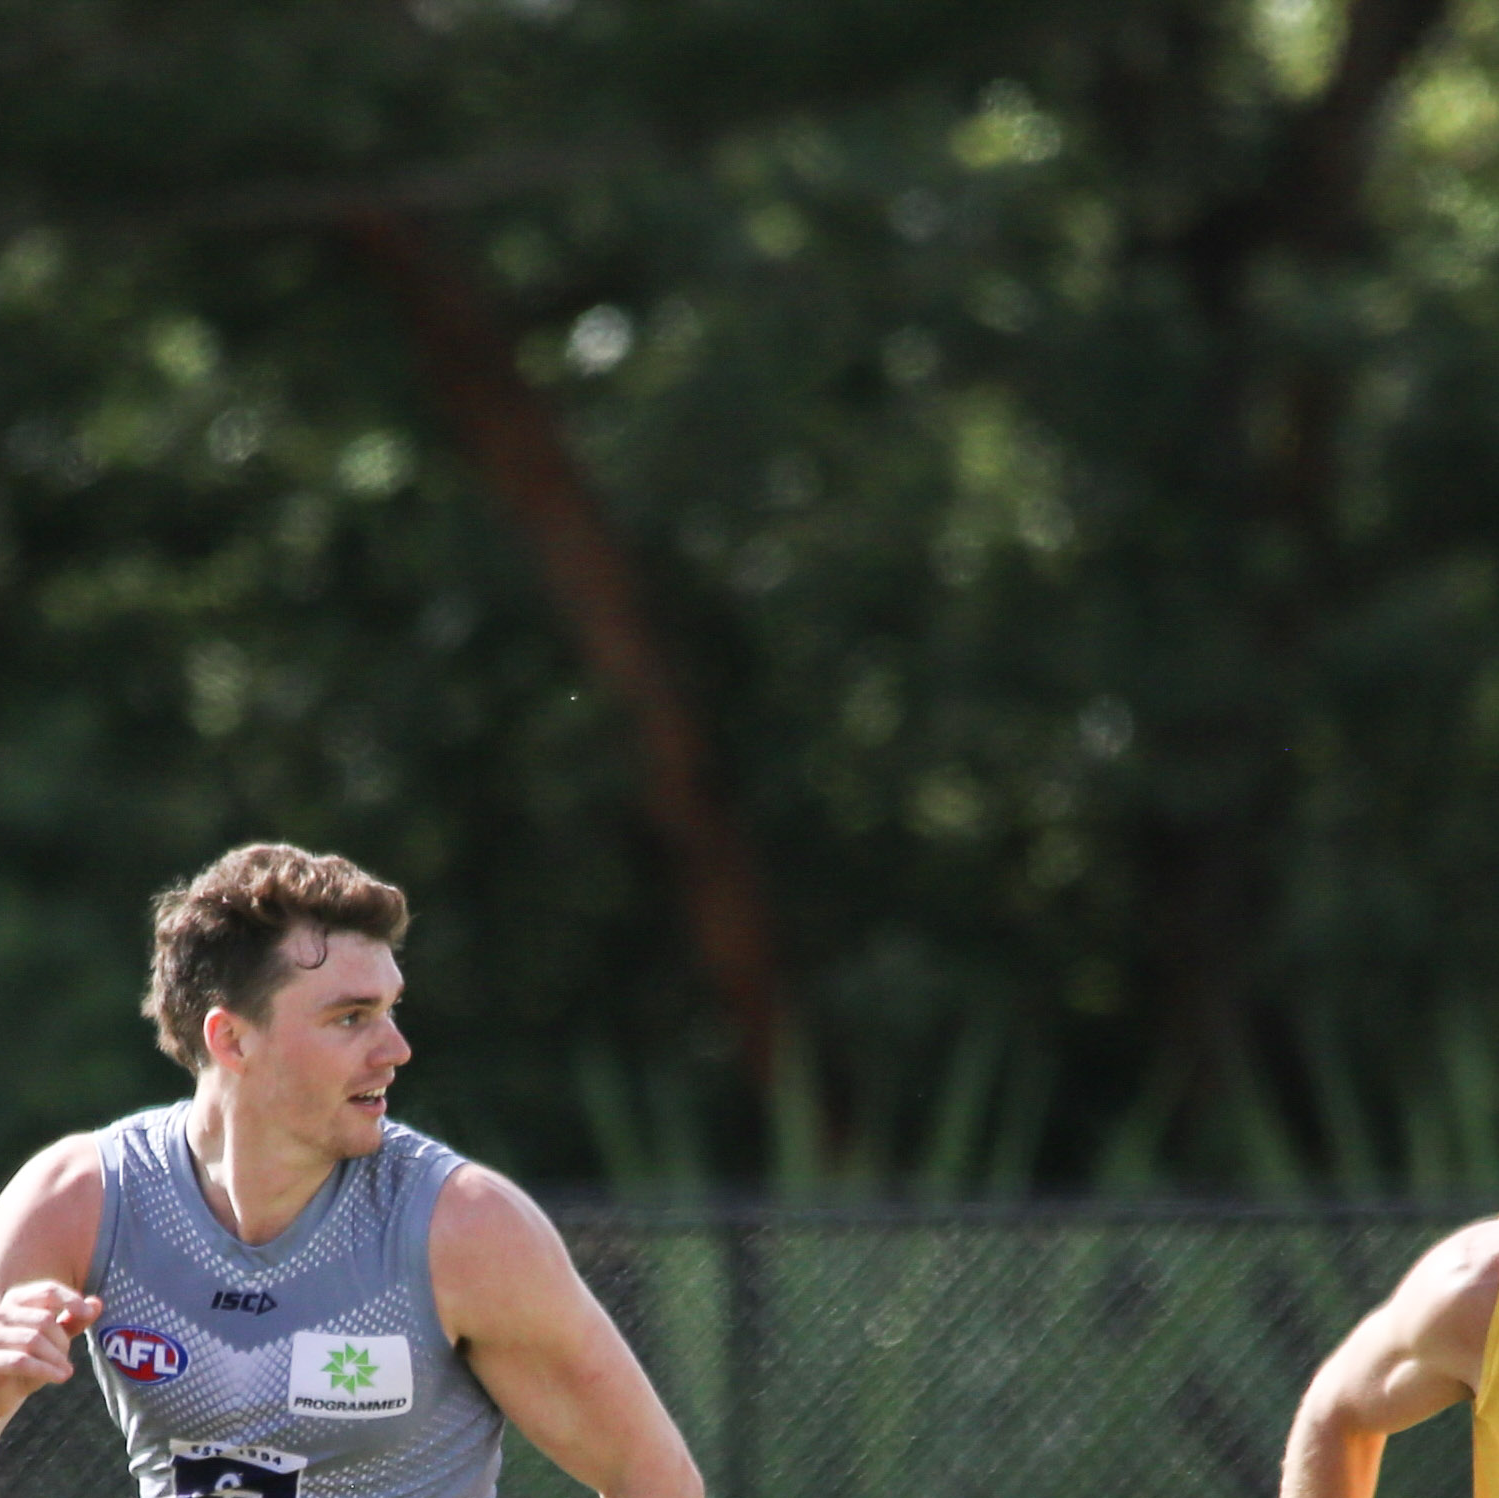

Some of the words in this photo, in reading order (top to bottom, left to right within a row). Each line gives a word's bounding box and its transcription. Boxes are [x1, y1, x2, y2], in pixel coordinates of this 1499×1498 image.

[105, 1335, 180, 1376] AFL
[293, 1395, 408, 1412] PROGRAMMED
[191, 1444, 222, 1456] EST
